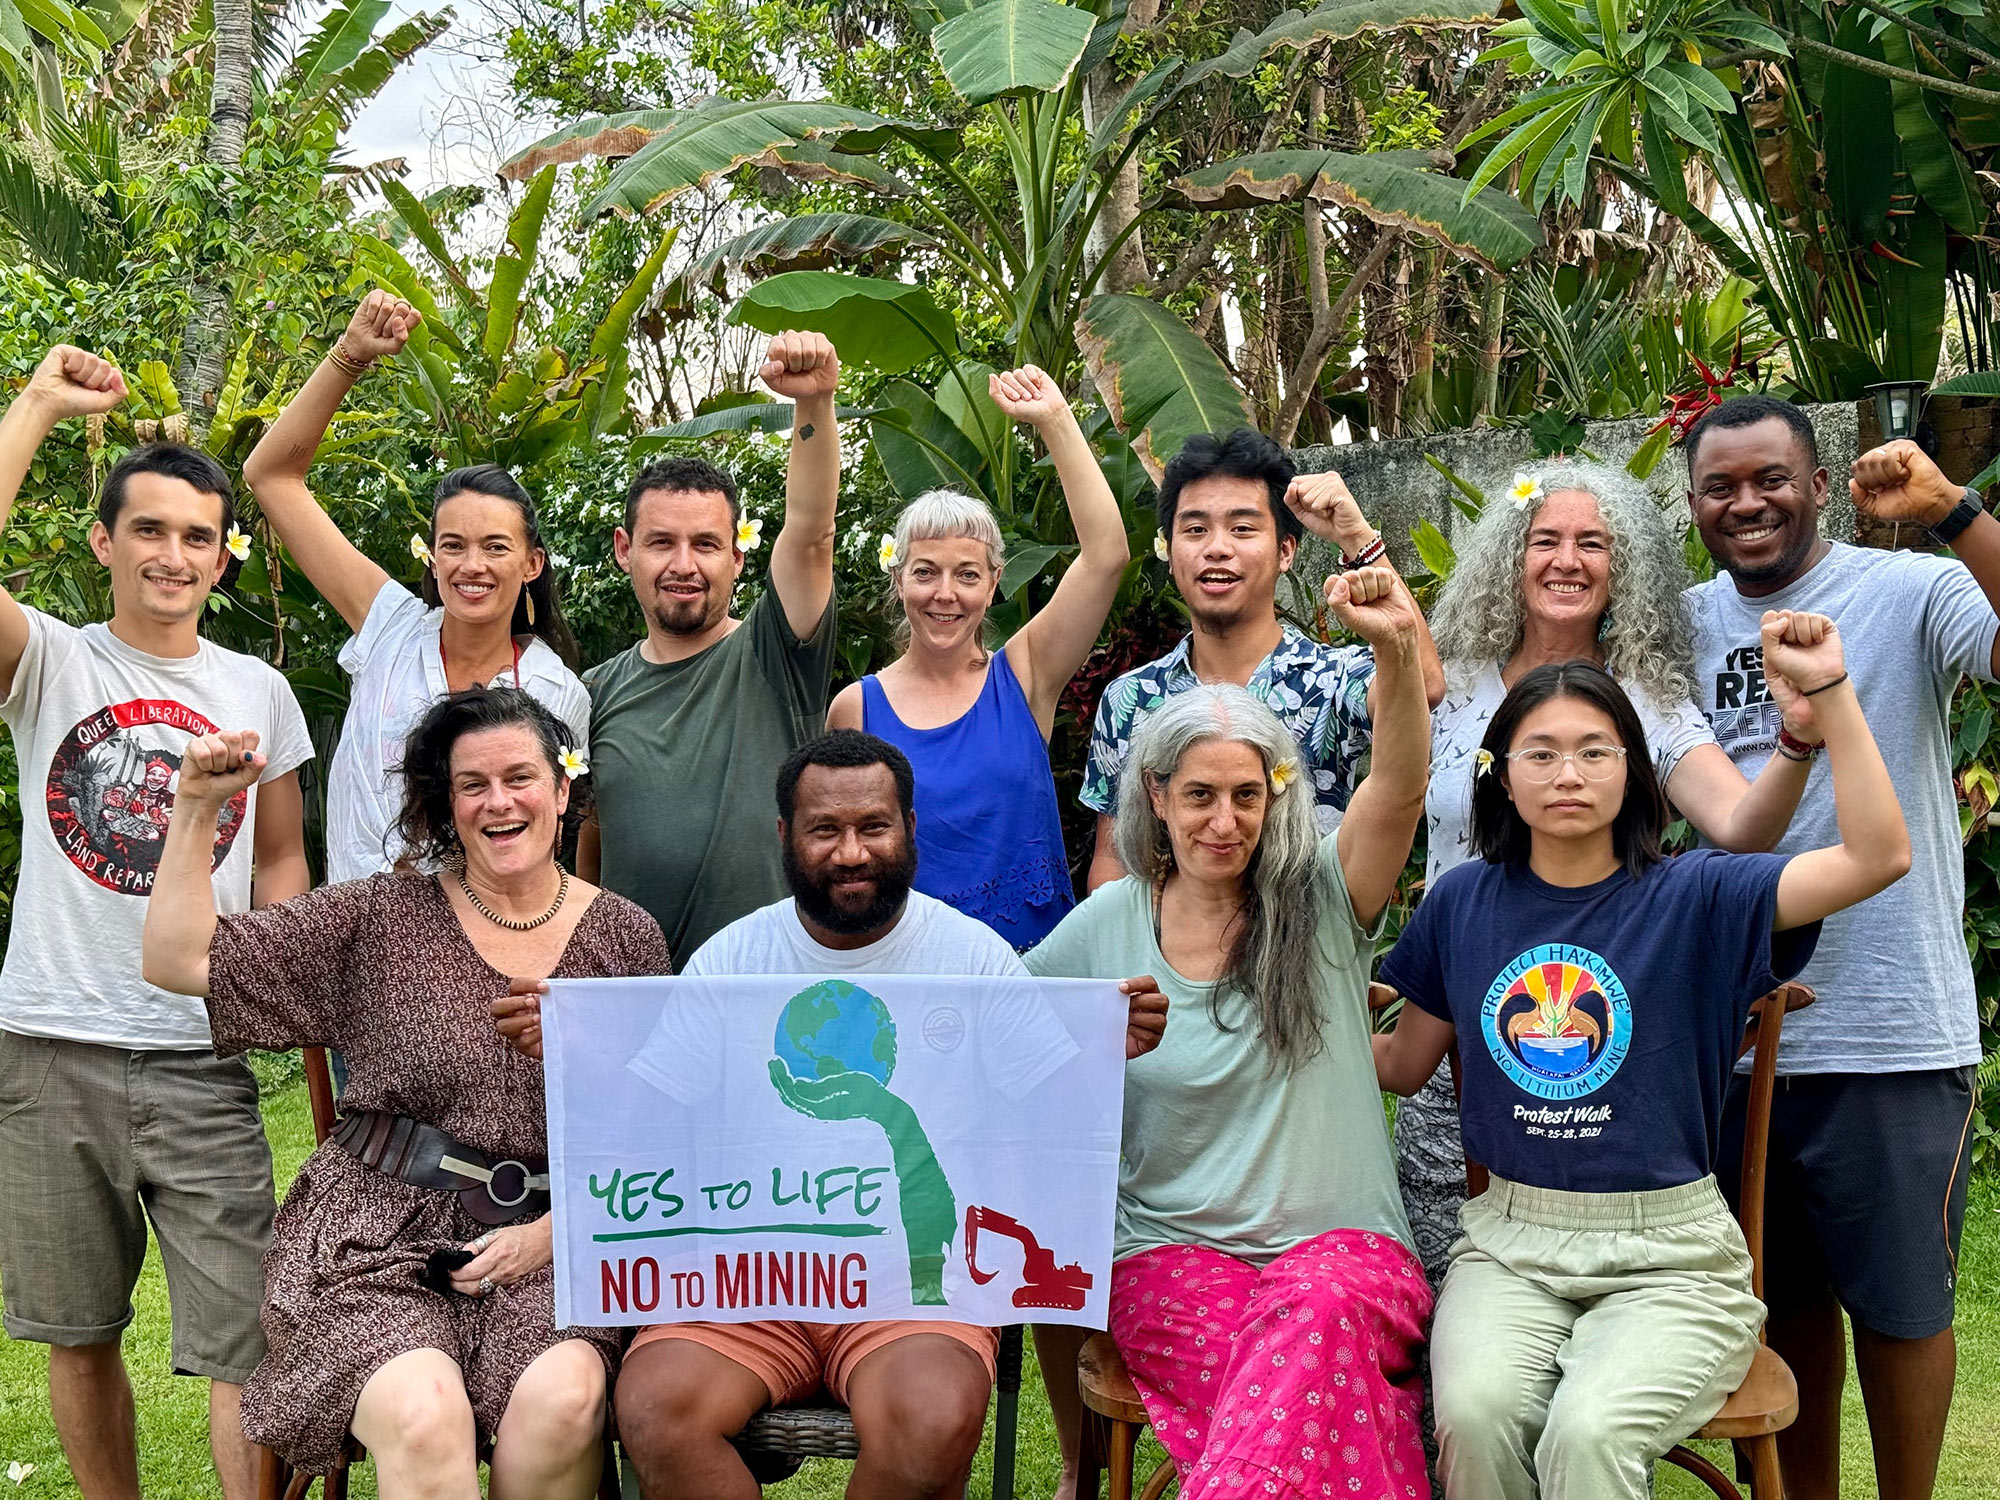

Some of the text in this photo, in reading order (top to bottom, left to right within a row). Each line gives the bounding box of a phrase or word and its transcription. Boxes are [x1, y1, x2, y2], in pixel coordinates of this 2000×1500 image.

[130, 705, 209, 735] LIBERATION
[66, 821, 98, 871] LAND
[1482, 949, 1538, 1018] PROTECT
[1492, 1042, 1628, 1098] NO LITHIUM MINE
[1513, 1104, 1612, 1124] Protest Walk
[1526, 1126, 1602, 1139] SEPT. 25-28, 2021
[588, 1166, 890, 1222] YES TO LIFE
[600, 1251, 868, 1313] NO TO MINING
